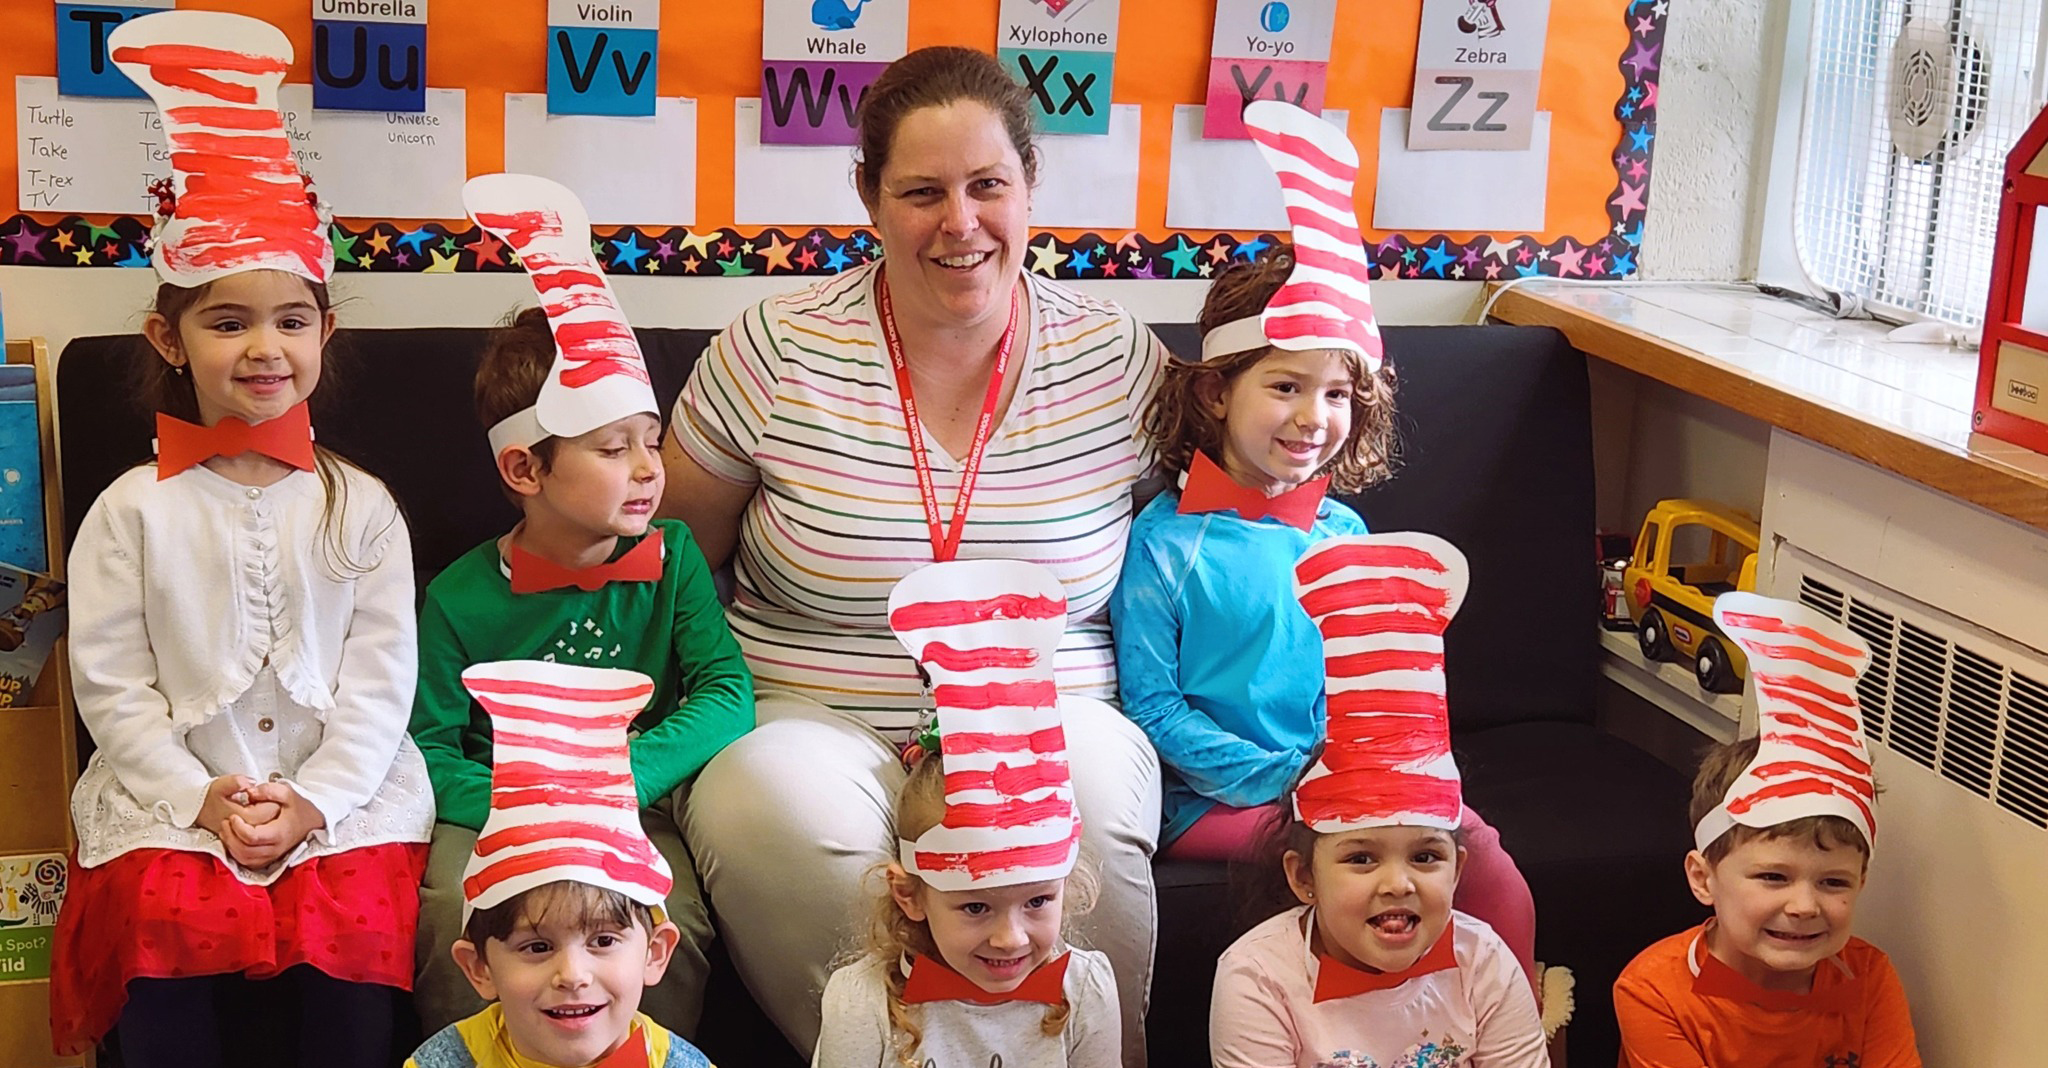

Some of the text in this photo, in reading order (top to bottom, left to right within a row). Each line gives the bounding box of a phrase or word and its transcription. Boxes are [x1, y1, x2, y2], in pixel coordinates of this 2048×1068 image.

[321, 0, 417, 17] Umbrella
[577, 3, 633, 22] Violin
[1008, 24, 1109, 47] Xylophone
[806, 37, 867, 56] Whale
[1246, 35, 1295, 57] Yo-yo
[1454, 47, 1508, 64] Zebra
[315, 24, 419, 92] Uu
[556, 30, 652, 96] Vv
[1017, 53, 1097, 117] Xx
[1426, 76, 1510, 132] Zz
[27, 105, 74, 128] Turtle
[138, 111, 162, 130] Te
[386, 111, 441, 126] Universe
[285, 126, 312, 141] nder
[28, 137, 68, 160] Take
[290, 147, 322, 165] pire
[27, 169, 74, 188] T-rex
[26, 191, 60, 208] TV
[977, 411, 991, 440] SCHOOL
[926, 496, 938, 526] SCHOOL
[6, 936, 47, 953] Spot?
[0, 956, 26, 973] ild
